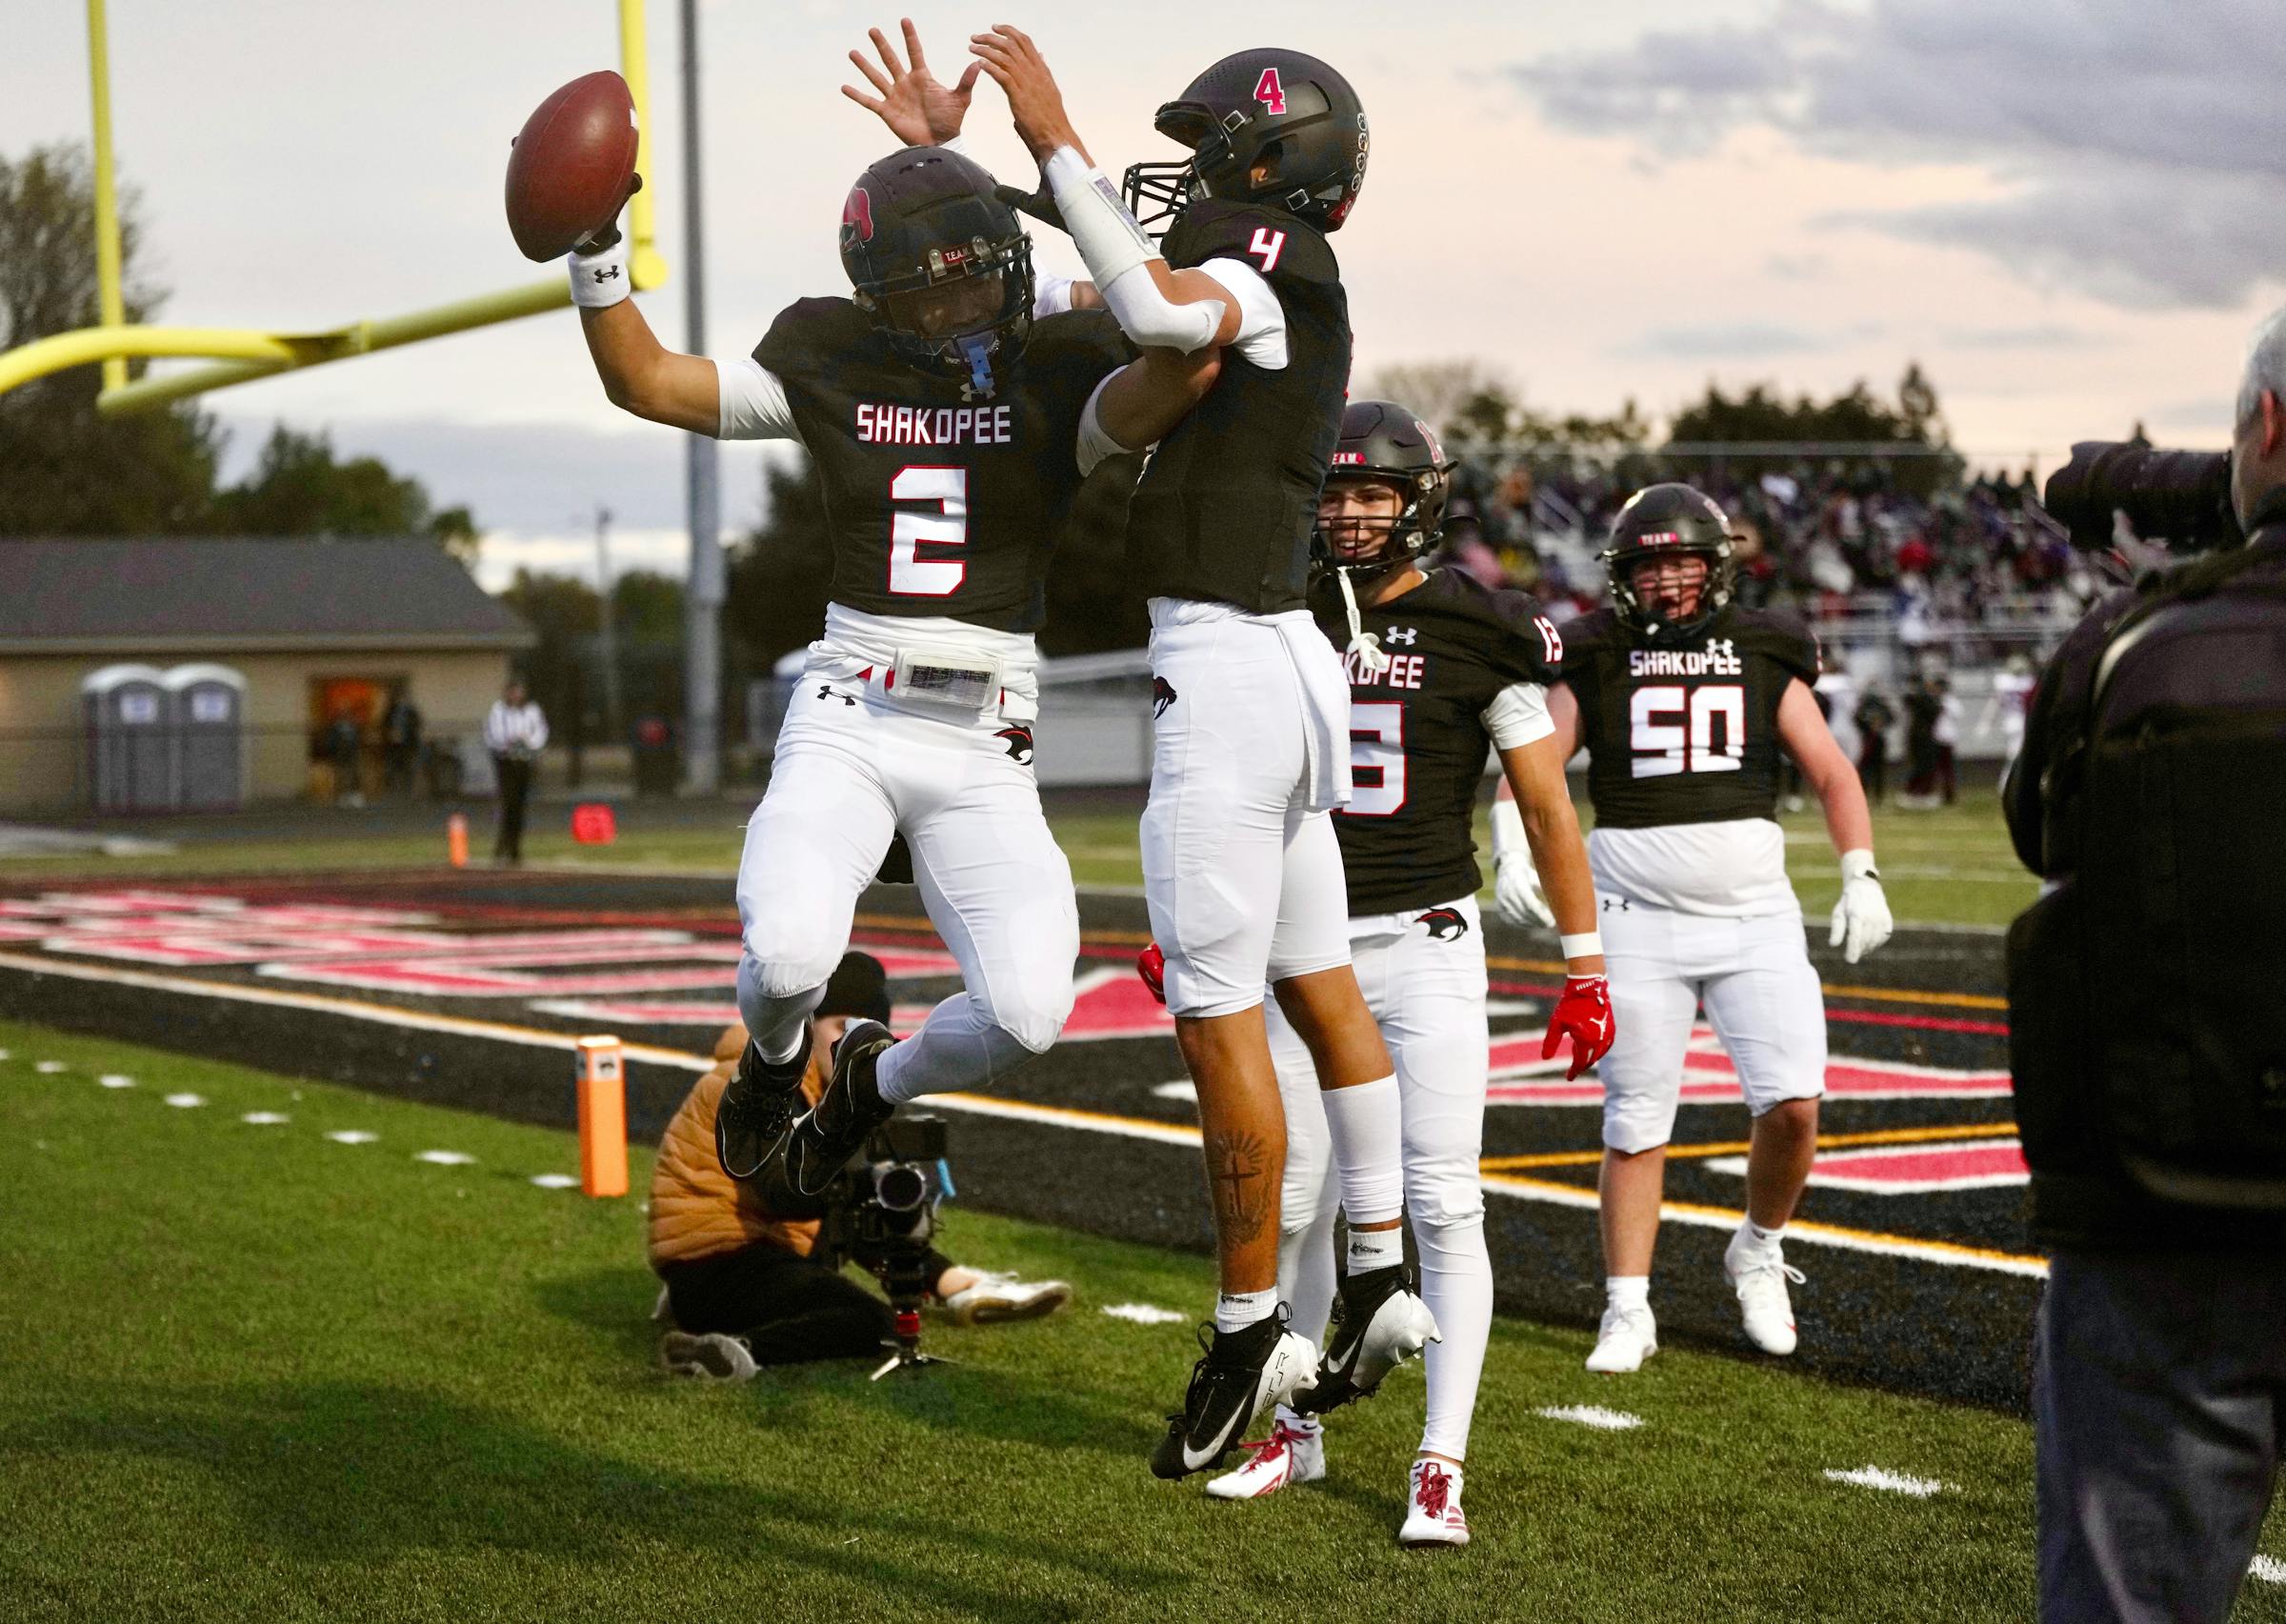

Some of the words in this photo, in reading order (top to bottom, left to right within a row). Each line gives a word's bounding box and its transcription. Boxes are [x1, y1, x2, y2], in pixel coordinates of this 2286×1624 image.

[1253, 68, 1286, 115] 4
[1248, 228, 1287, 272] 4
[856, 404, 1012, 444] SHAKOPEE
[888, 465, 968, 598] 2
[1532, 614, 1564, 664] 13
[1630, 650, 1742, 676] SHAKOPEE
[1630, 686, 1745, 779] 50
